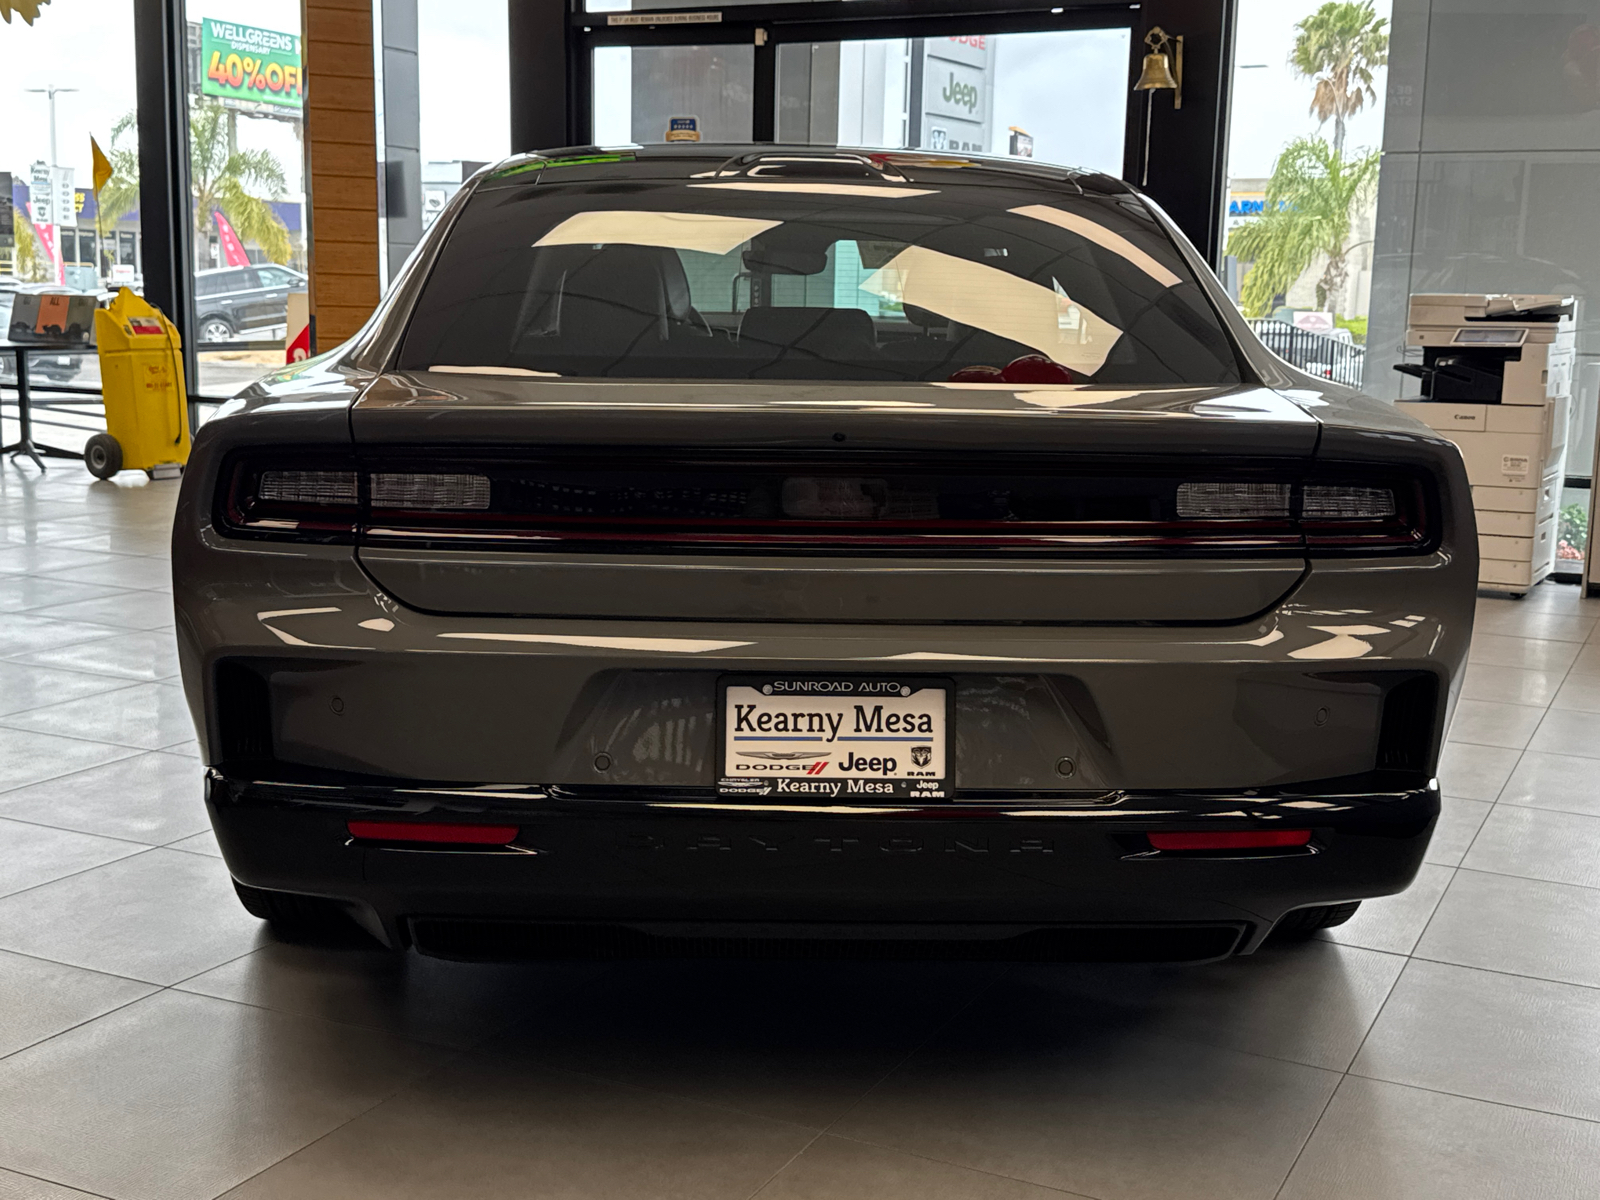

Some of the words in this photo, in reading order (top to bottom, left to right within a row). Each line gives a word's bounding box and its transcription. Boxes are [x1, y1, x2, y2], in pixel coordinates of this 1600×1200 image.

[210, 21, 292, 51] WELLGREENS
[231, 41, 271, 55] DISPENSARY
[942, 71, 978, 114] Jeep
[33, 196, 51, 206] Jeep
[773, 681, 854, 692] SUNROAD
[858, 682, 900, 693] AUTO
[734, 704, 843, 742] Kearny
[853, 705, 933, 733] Mesa
[838, 752, 897, 776] Jeep
[776, 778, 841, 797] Kearny
[846, 779, 894, 794] Mesa
[916, 780, 939, 791] Jeep
